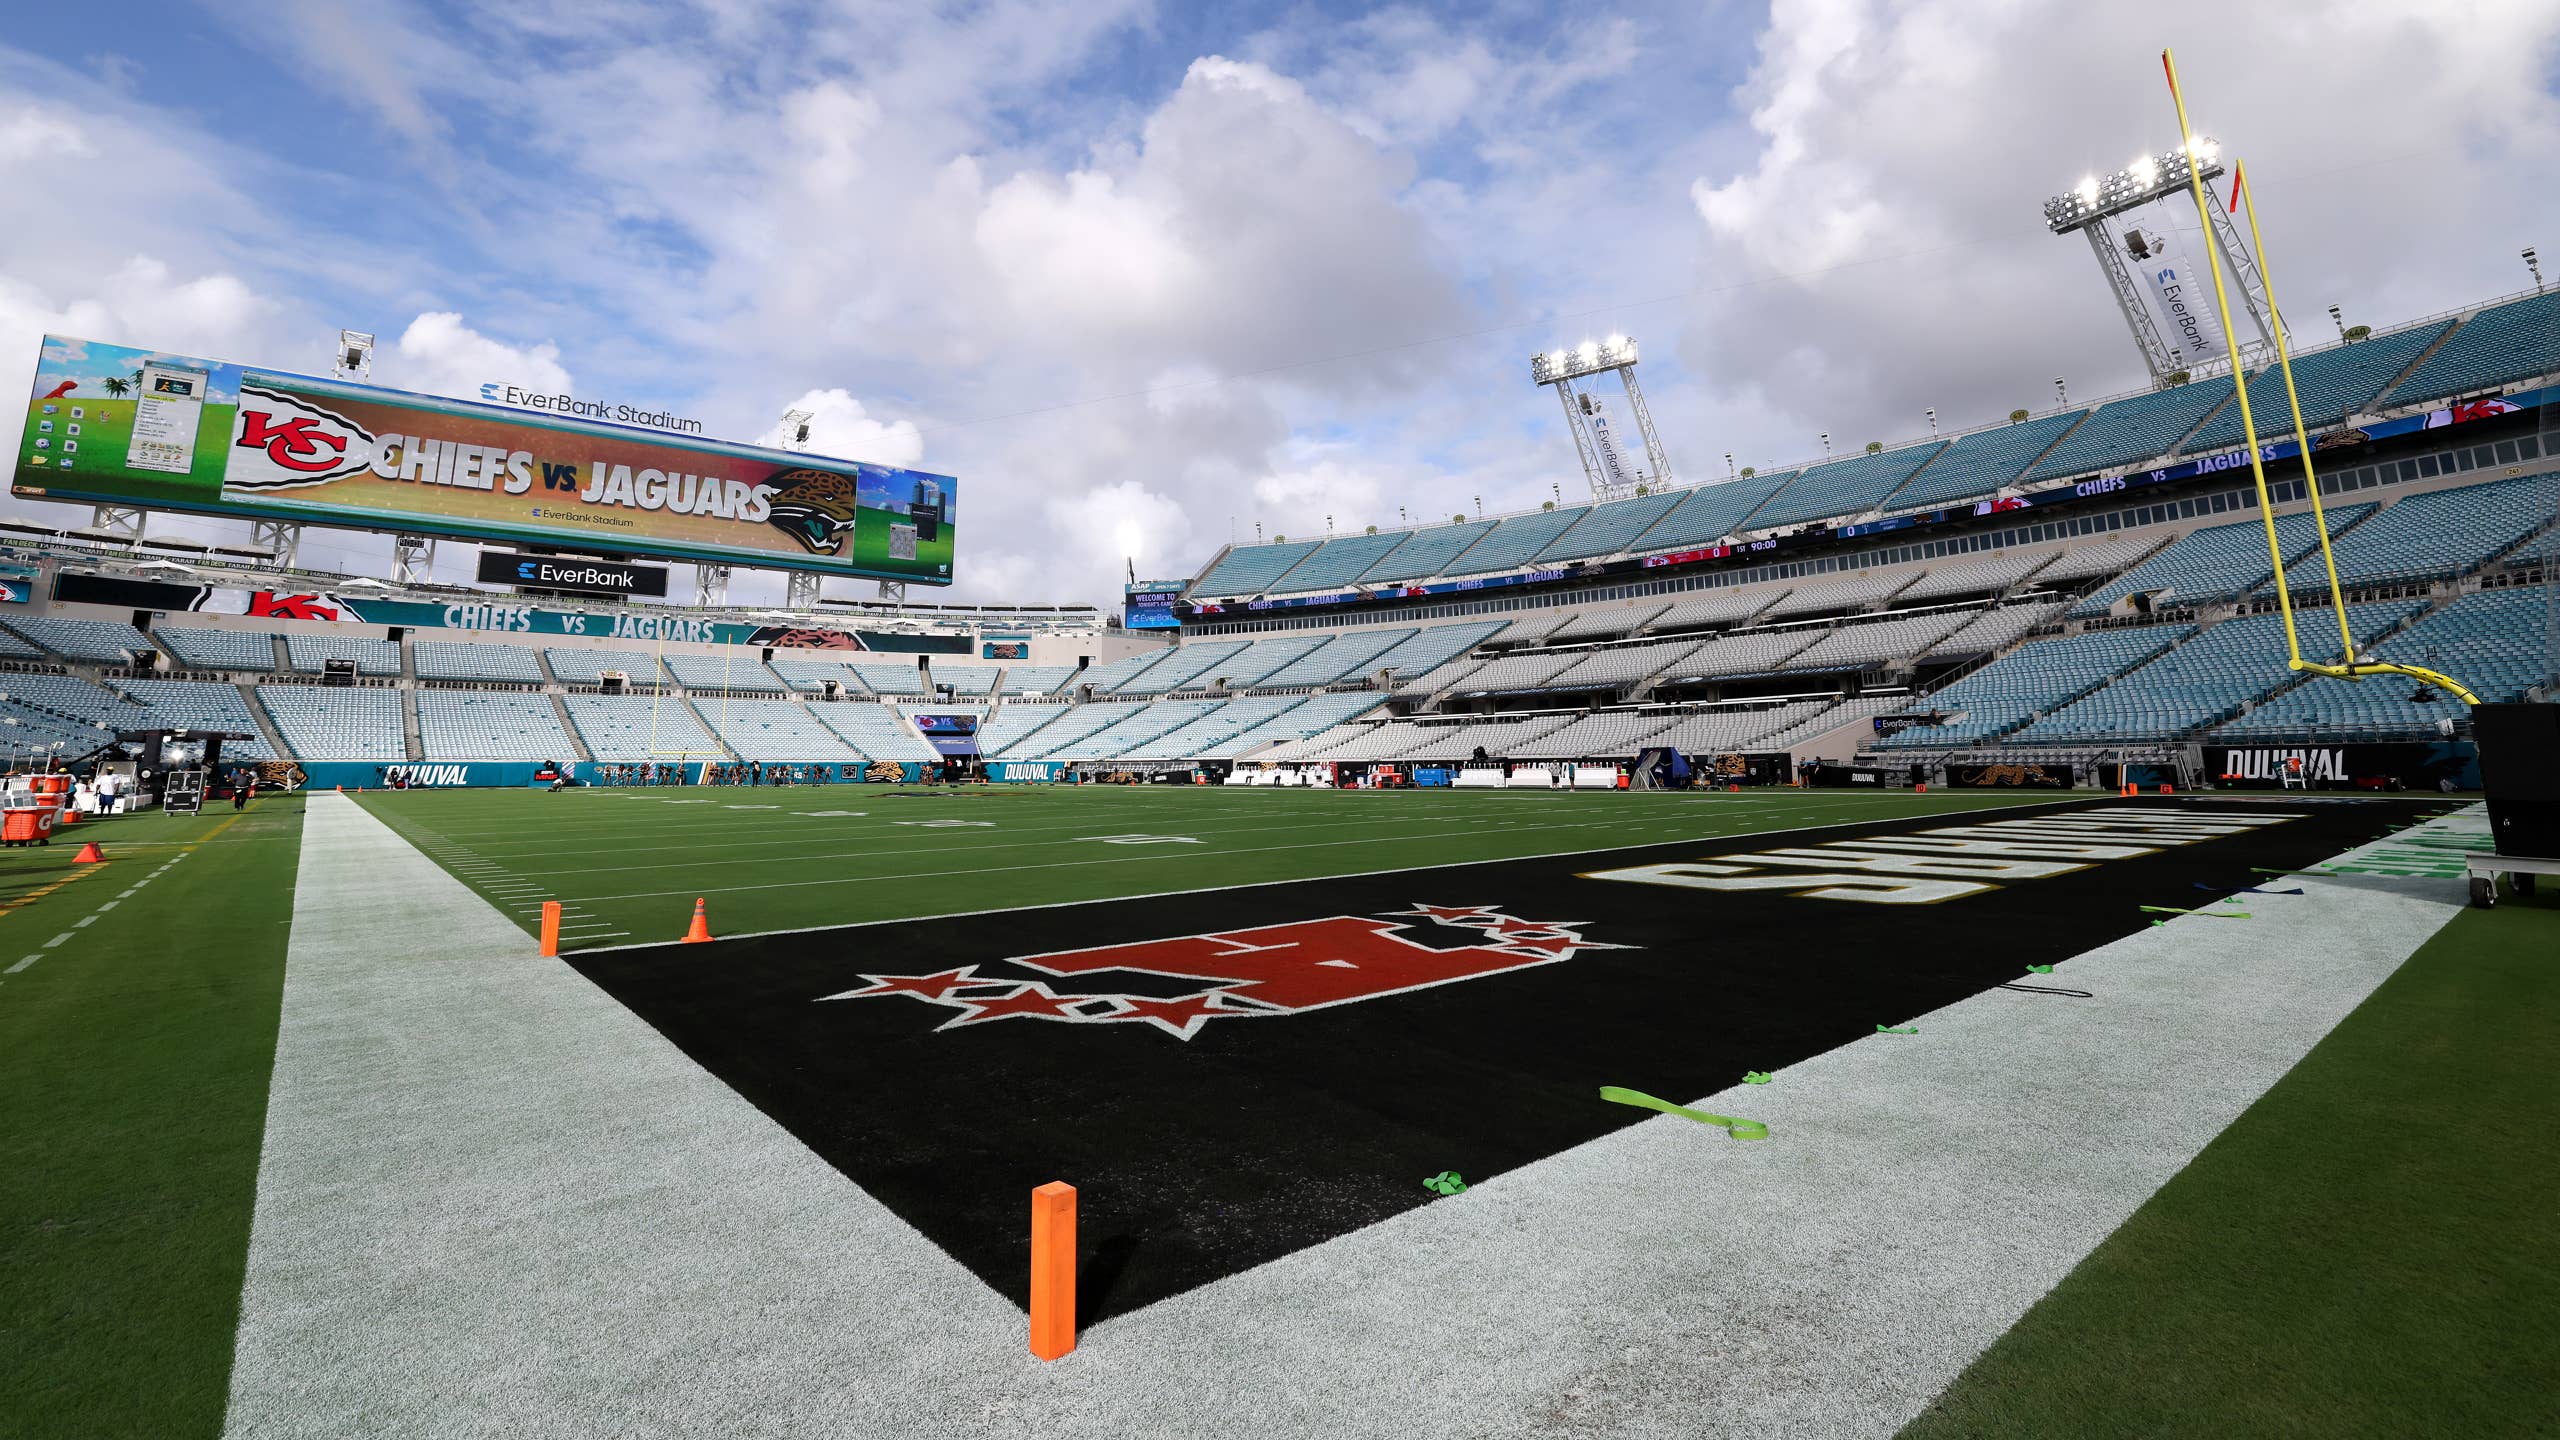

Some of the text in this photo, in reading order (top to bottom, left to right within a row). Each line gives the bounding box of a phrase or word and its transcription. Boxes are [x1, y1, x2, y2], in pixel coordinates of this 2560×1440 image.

[2163, 284, 2210, 352] EverBank
[506, 386, 702, 433] EverBank Stadium
[1598, 429, 1625, 479] EverBank
[369, 433, 772, 523] CHIEFS VS. JAGUARS
[2076, 476, 2126, 497] CHIEFS
[2151, 469, 2167, 483] VS
[542, 510, 634, 528] EverBank Stadium
[1713, 548, 1720, 558] 0
[1750, 539, 1777, 551] 90:00
[540, 564, 634, 588] EverBank
[1456, 579, 1484, 591] CHIEFS
[1523, 569, 1565, 584] JAGUARS
[1136, 593, 1176, 602] WELCOME TO
[1248, 601, 1273, 610] CHIEFS
[1305, 595, 1341, 606] JAGUARS
[443, 605, 714, 643] CHIEFS VS JAGUARS
[940, 717, 951, 726] VS
[1882, 719, 1918, 729] EverBank
[1004, 764, 1049, 780] DUUUVAL
[38, 813, 52, 831] G
